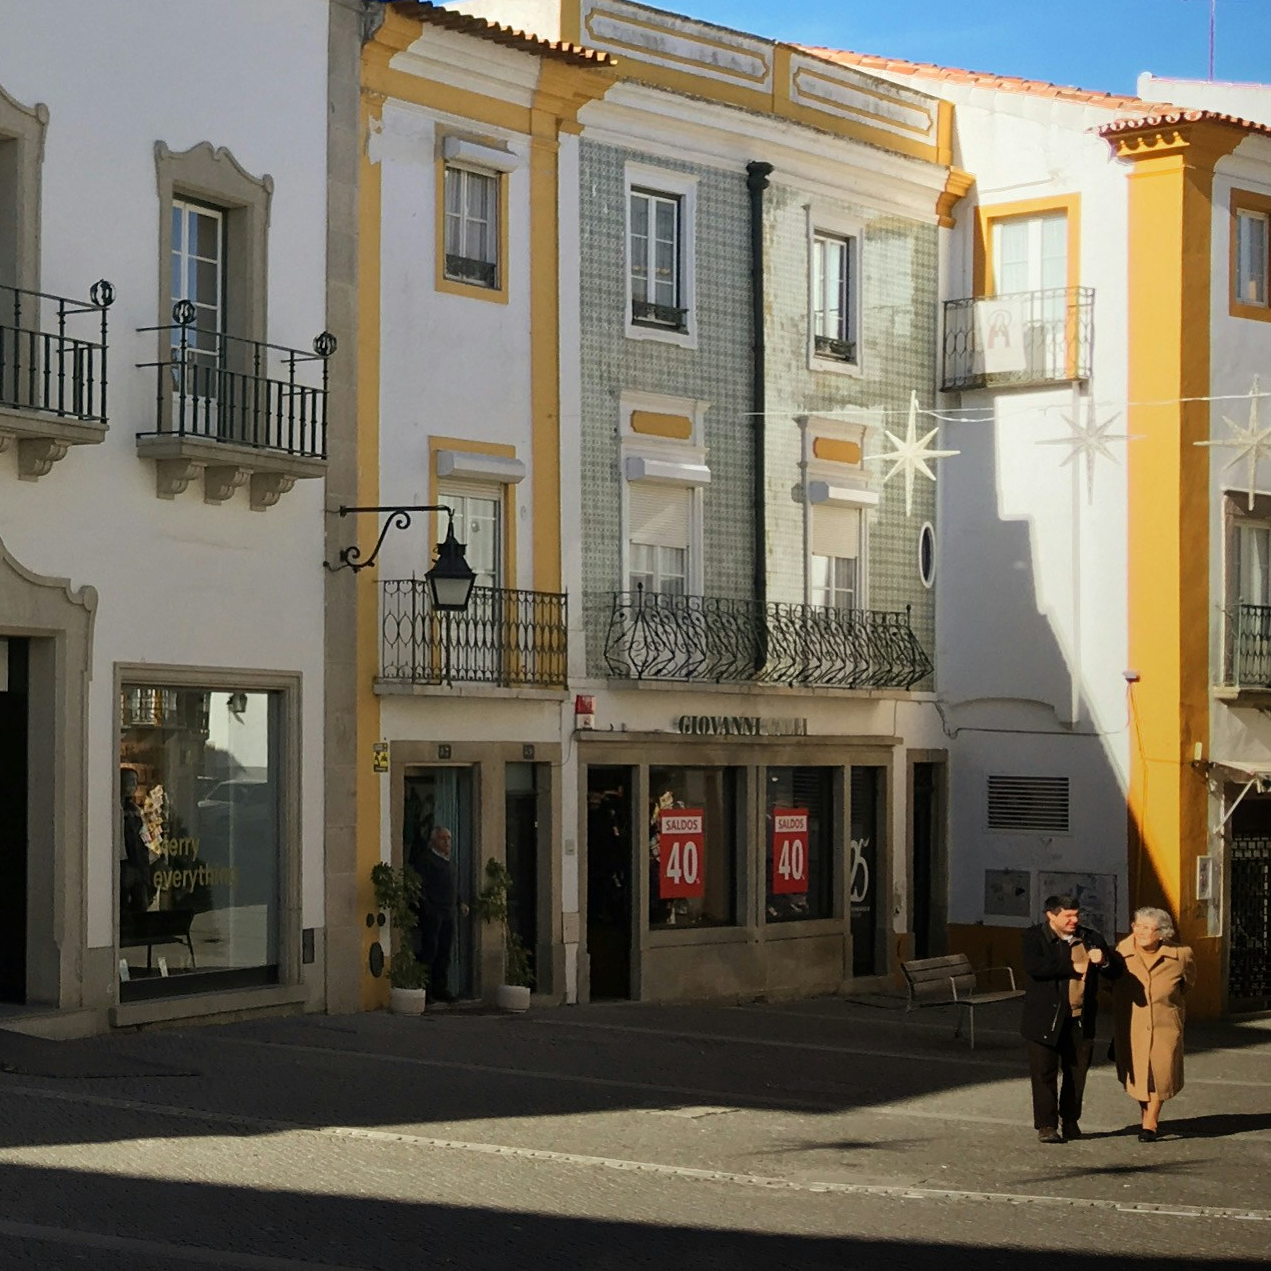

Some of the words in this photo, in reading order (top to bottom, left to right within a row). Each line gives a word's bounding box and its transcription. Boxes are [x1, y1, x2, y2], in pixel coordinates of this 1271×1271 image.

[678, 715, 762, 736] GIOVANNI
[666, 819, 698, 832] SALDOS
[778, 818, 805, 830] SALDOS
[156, 836, 200, 862] erry
